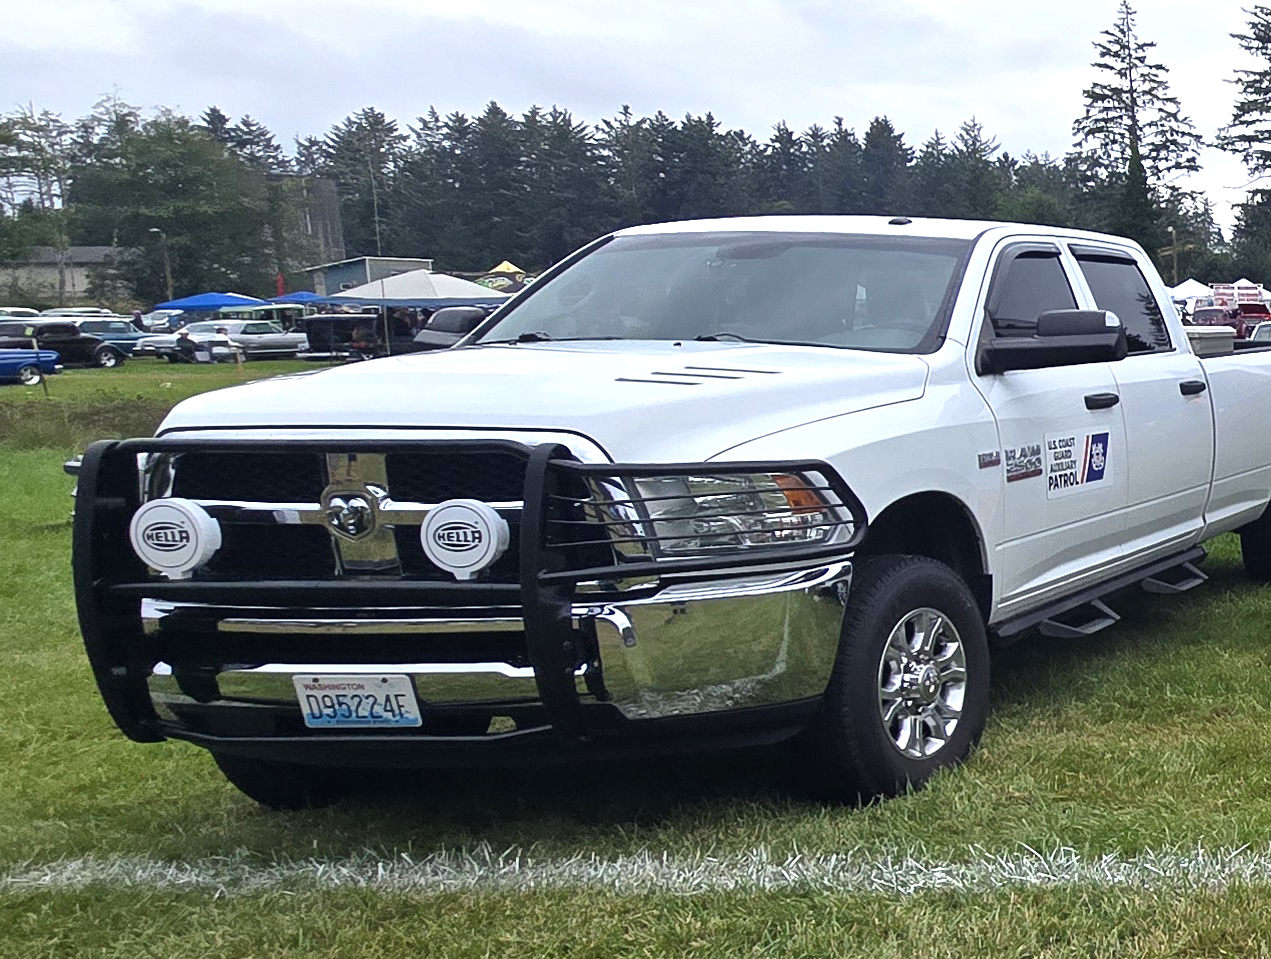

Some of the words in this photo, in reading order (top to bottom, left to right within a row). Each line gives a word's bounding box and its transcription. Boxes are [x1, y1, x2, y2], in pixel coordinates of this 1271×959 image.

[1048, 471, 1080, 492] PATROL
[147, 529, 190, 544] HELLA
[437, 529, 482, 544] HELLA
[303, 683, 366, 691] WASHINGTON
[305, 693, 407, 720] D95224F
